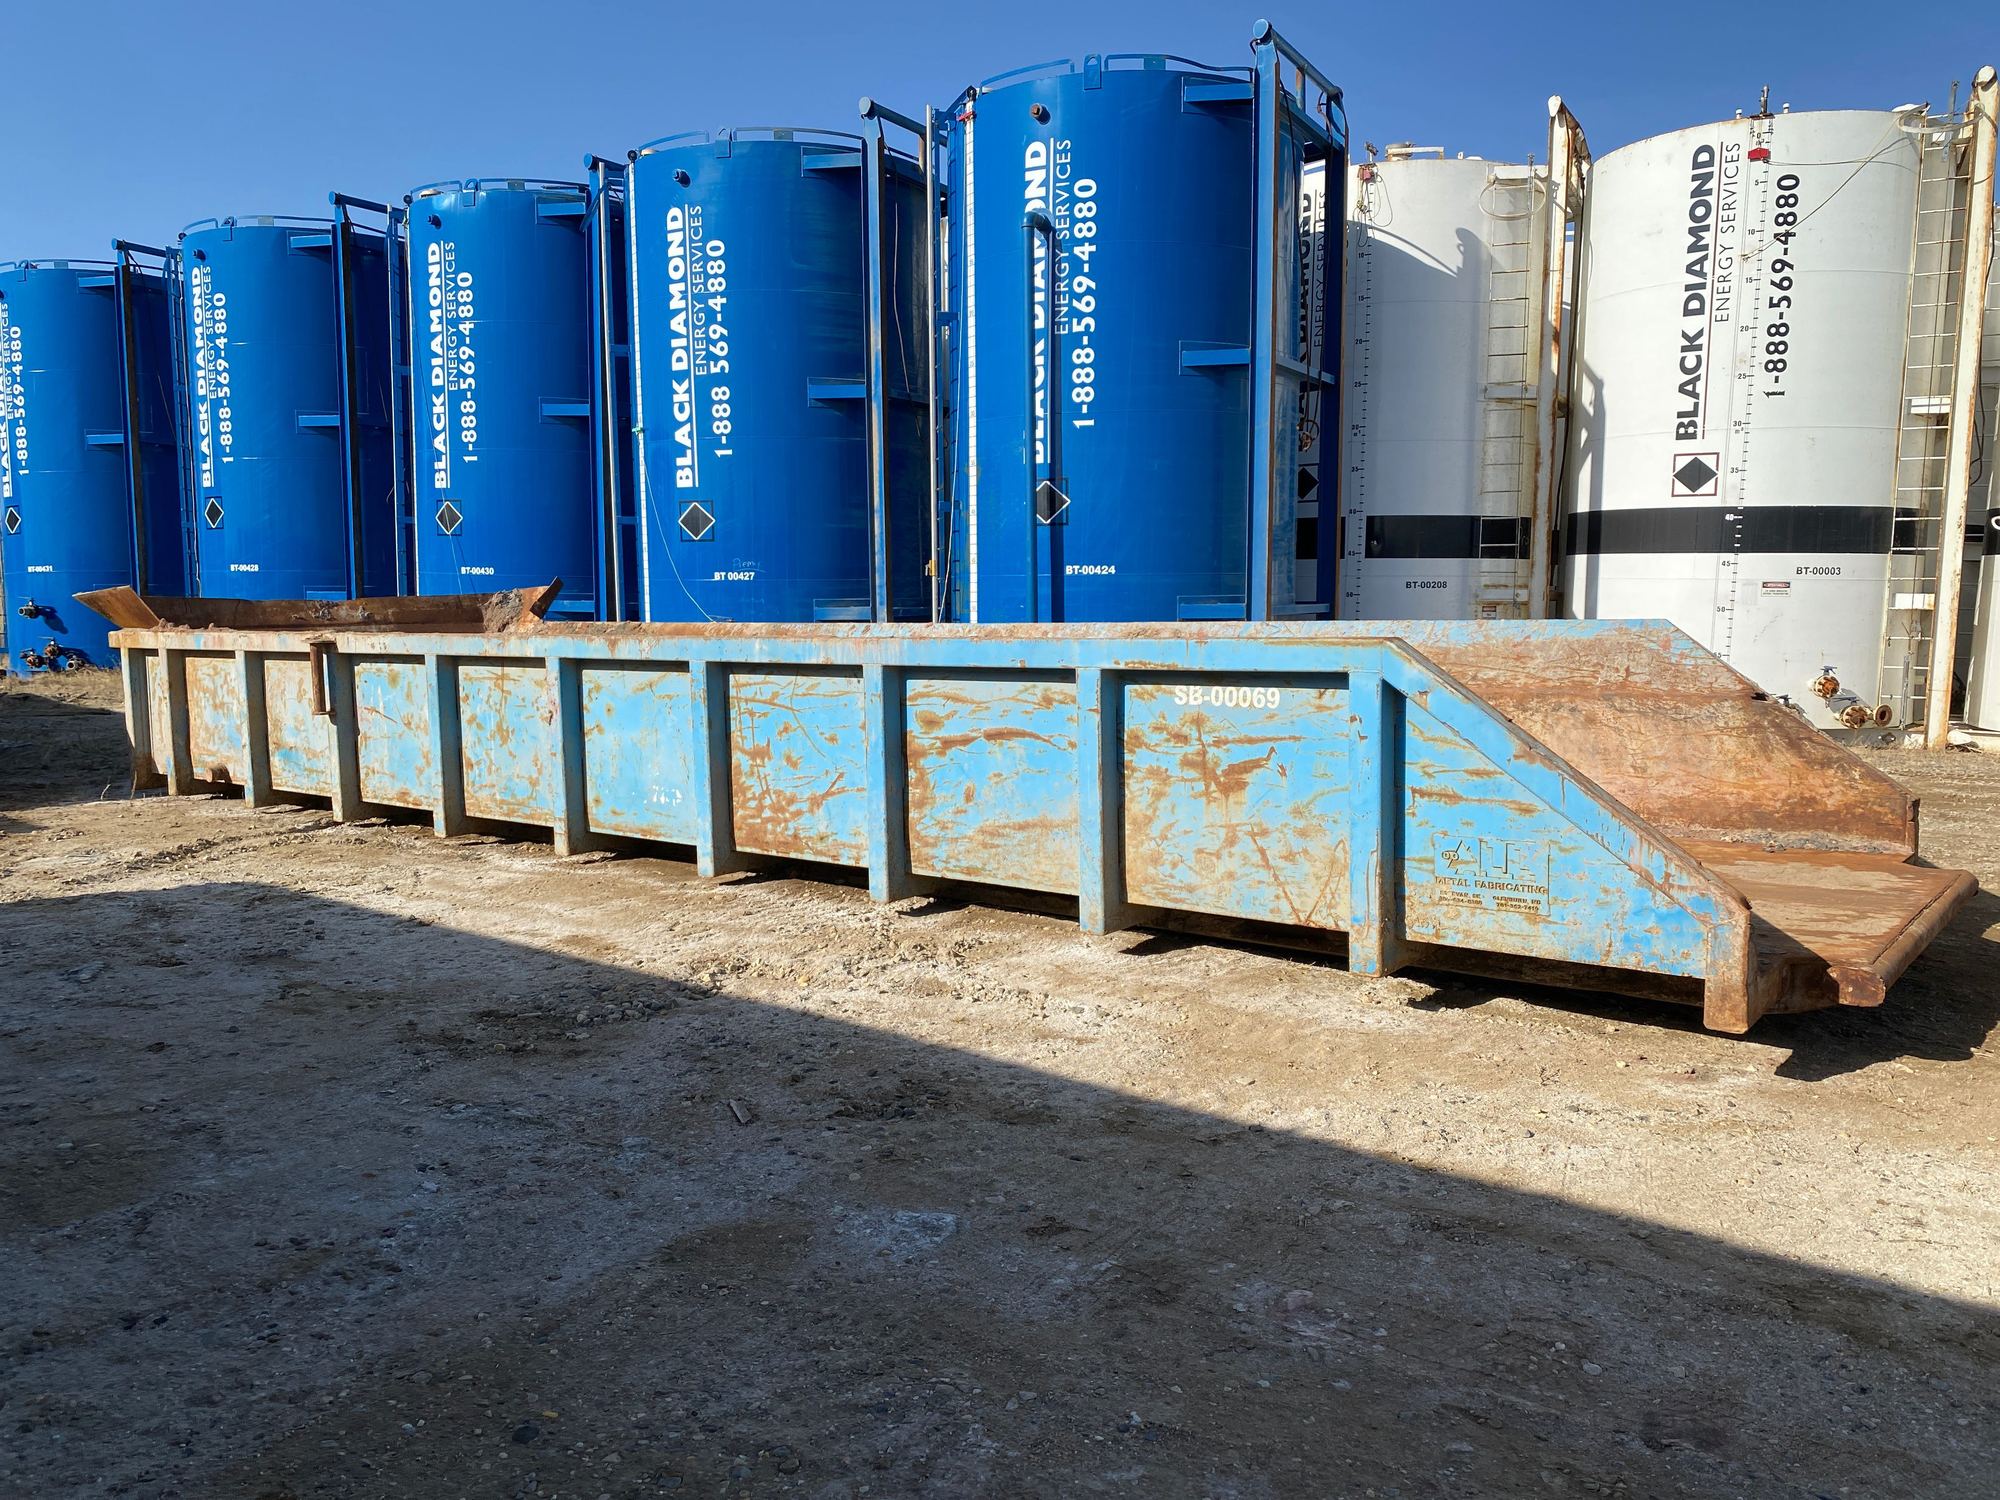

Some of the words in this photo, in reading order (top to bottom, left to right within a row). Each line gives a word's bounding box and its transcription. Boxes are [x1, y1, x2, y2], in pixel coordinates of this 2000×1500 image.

[1055, 139, 1071, 240] SERVICES
[1721, 142, 1741, 233] SERVICES
[690, 205, 705, 294] SERVICES
[1683, 144, 1715, 317] DIAMOND
[204, 265, 213, 336] SERVICES
[428, 243, 443, 387] DIAMOND
[445, 242, 456, 318] SERVICES
[667, 207, 688, 371] DIAMOND
[706, 240, 730, 374] 569-4880
[1055, 251, 1070, 335] ENERGY
[1072, 178, 1097, 429] 1-888-569-4880
[1715, 247, 1735, 323] ENERGY
[1763, 174, 1800, 398] 1-888-569-4880
[1, 303, 11, 363] SERVICES
[191, 267, 206, 382] DIAMOND
[447, 326, 458, 391] ENERGY
[693, 301, 707, 375] ENERGY
[1740, 324, 1750, 332] 20
[5, 368, 14, 420] ENERGY
[10, 326, 30, 476] 1-888-569-4880
[207, 343, 217, 400] ENERGY
[214, 292, 234, 463] 1-888-569-4880
[457, 272, 478, 463] 1-888-569-4880
[1675, 328, 1705, 440] BLACK
[1738, 372, 1747, 380] 25
[0, 423, 10, 498] BLACK
[199, 402, 211, 488] BLACK
[433, 393, 447, 488] BLACK
[672, 379, 694, 488] BLACK
[461, 566, 494, 575] BT-00430
[727, 571, 755, 580] 00427
[1065, 564, 1116, 575] BT-00424
[1406, 580, 1447, 589] BT-00208
[1796, 566, 1841, 576] BT-00003
[1174, 686, 1280, 709] SB-00069
[1435, 876, 1471, 888] METAL
[1474, 880, 1549, 896] FABRICATING
